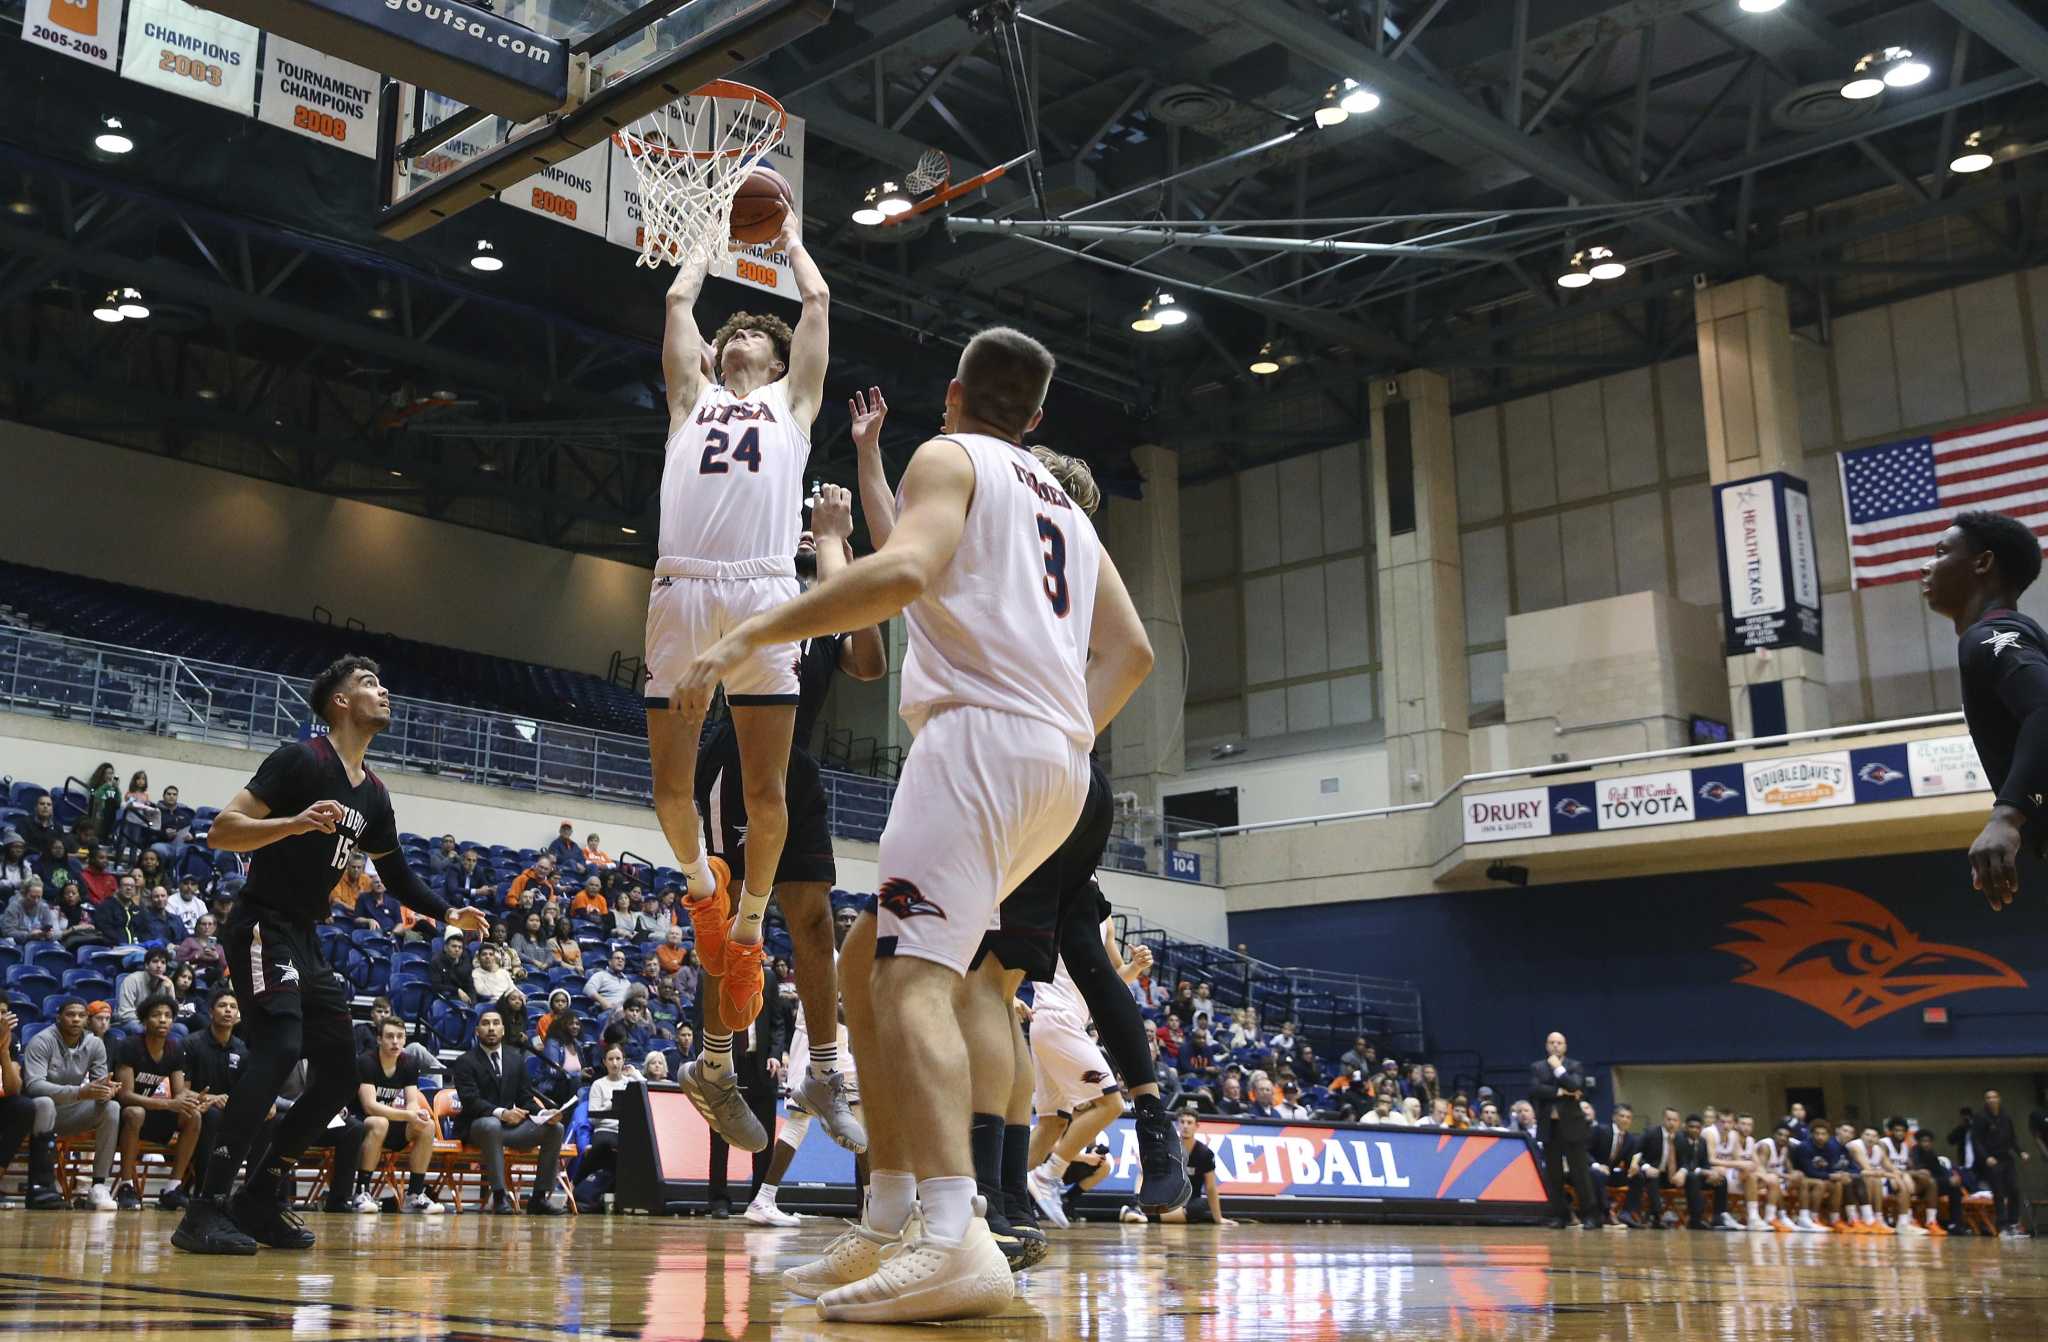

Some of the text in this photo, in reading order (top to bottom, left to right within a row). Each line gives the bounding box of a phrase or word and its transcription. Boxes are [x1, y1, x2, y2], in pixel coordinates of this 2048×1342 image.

[32, 25, 107, 60] 2005-2009
[144, 22, 241, 66] CHAMPIONS
[385, 0, 550, 64] goutsa.com
[159, 49, 223, 88] 2003
[276, 58, 372, 104] TOURNAMENT
[280, 78, 364, 119] CHAMPIONS
[294, 104, 346, 142] 2008
[532, 188, 577, 221] 2009
[737, 257, 777, 288] 2009
[696, 401, 777, 425] UTSA
[699, 427, 761, 474] 24
[1036, 512, 1071, 618] 3
[1742, 509, 1763, 606] HEALTHTEXAS
[310, 723, 330, 734] SECT
[1472, 800, 1541, 824] DRURY
[1602, 796, 1688, 819] TOYOTA
[331, 834, 354, 870] 15
[1173, 857, 1195, 873] 104
[1095, 1130, 1411, 1188] AKETBALL
